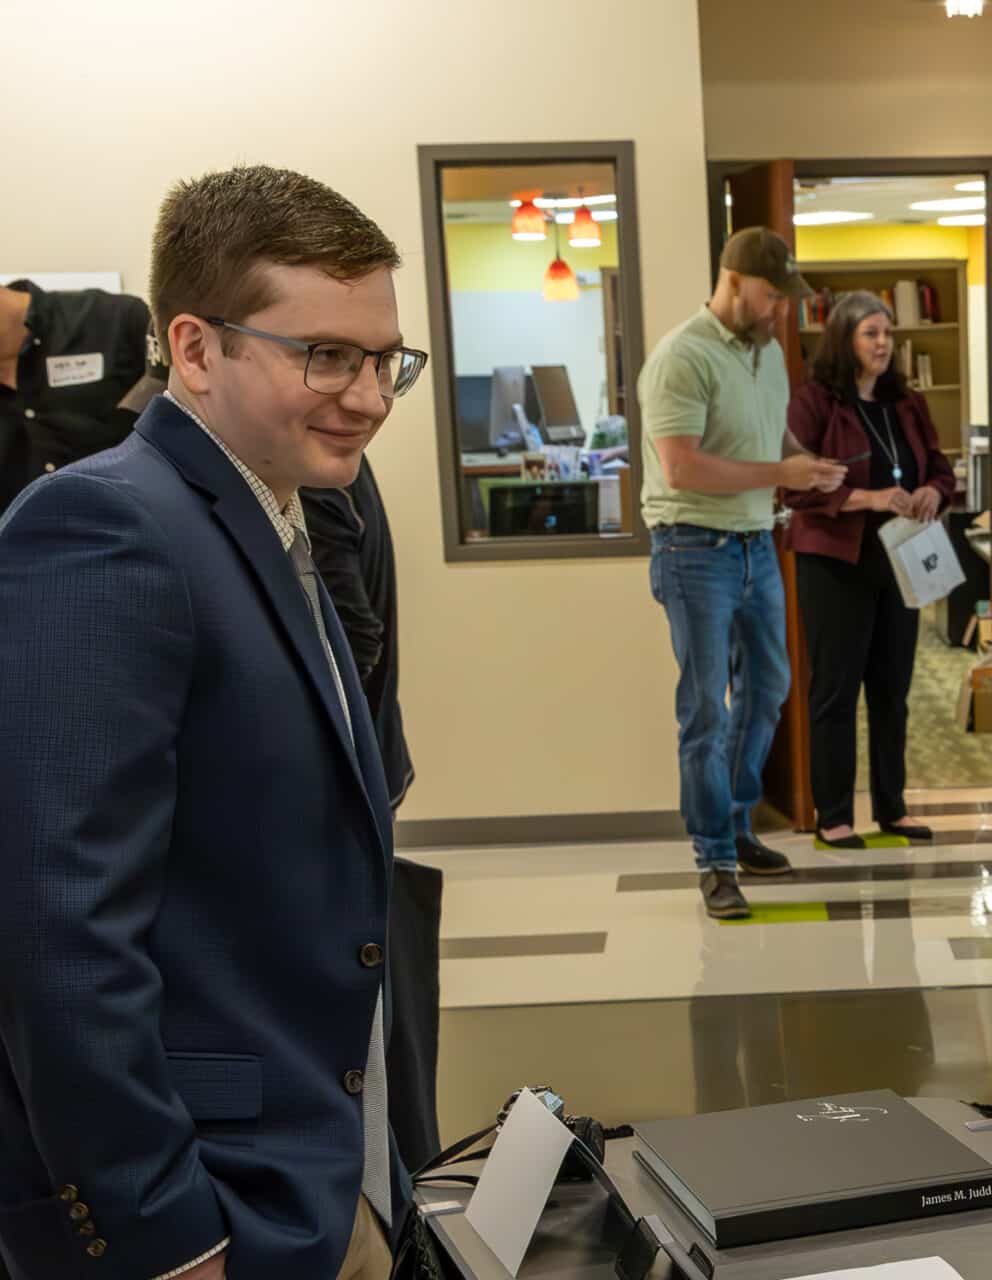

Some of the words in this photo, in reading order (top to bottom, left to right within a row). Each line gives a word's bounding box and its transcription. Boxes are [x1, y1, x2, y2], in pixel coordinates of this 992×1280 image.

[921, 1193, 952, 1208] James
[953, 1190, 967, 1201] M.
[969, 1184, 992, 1200] Judd
